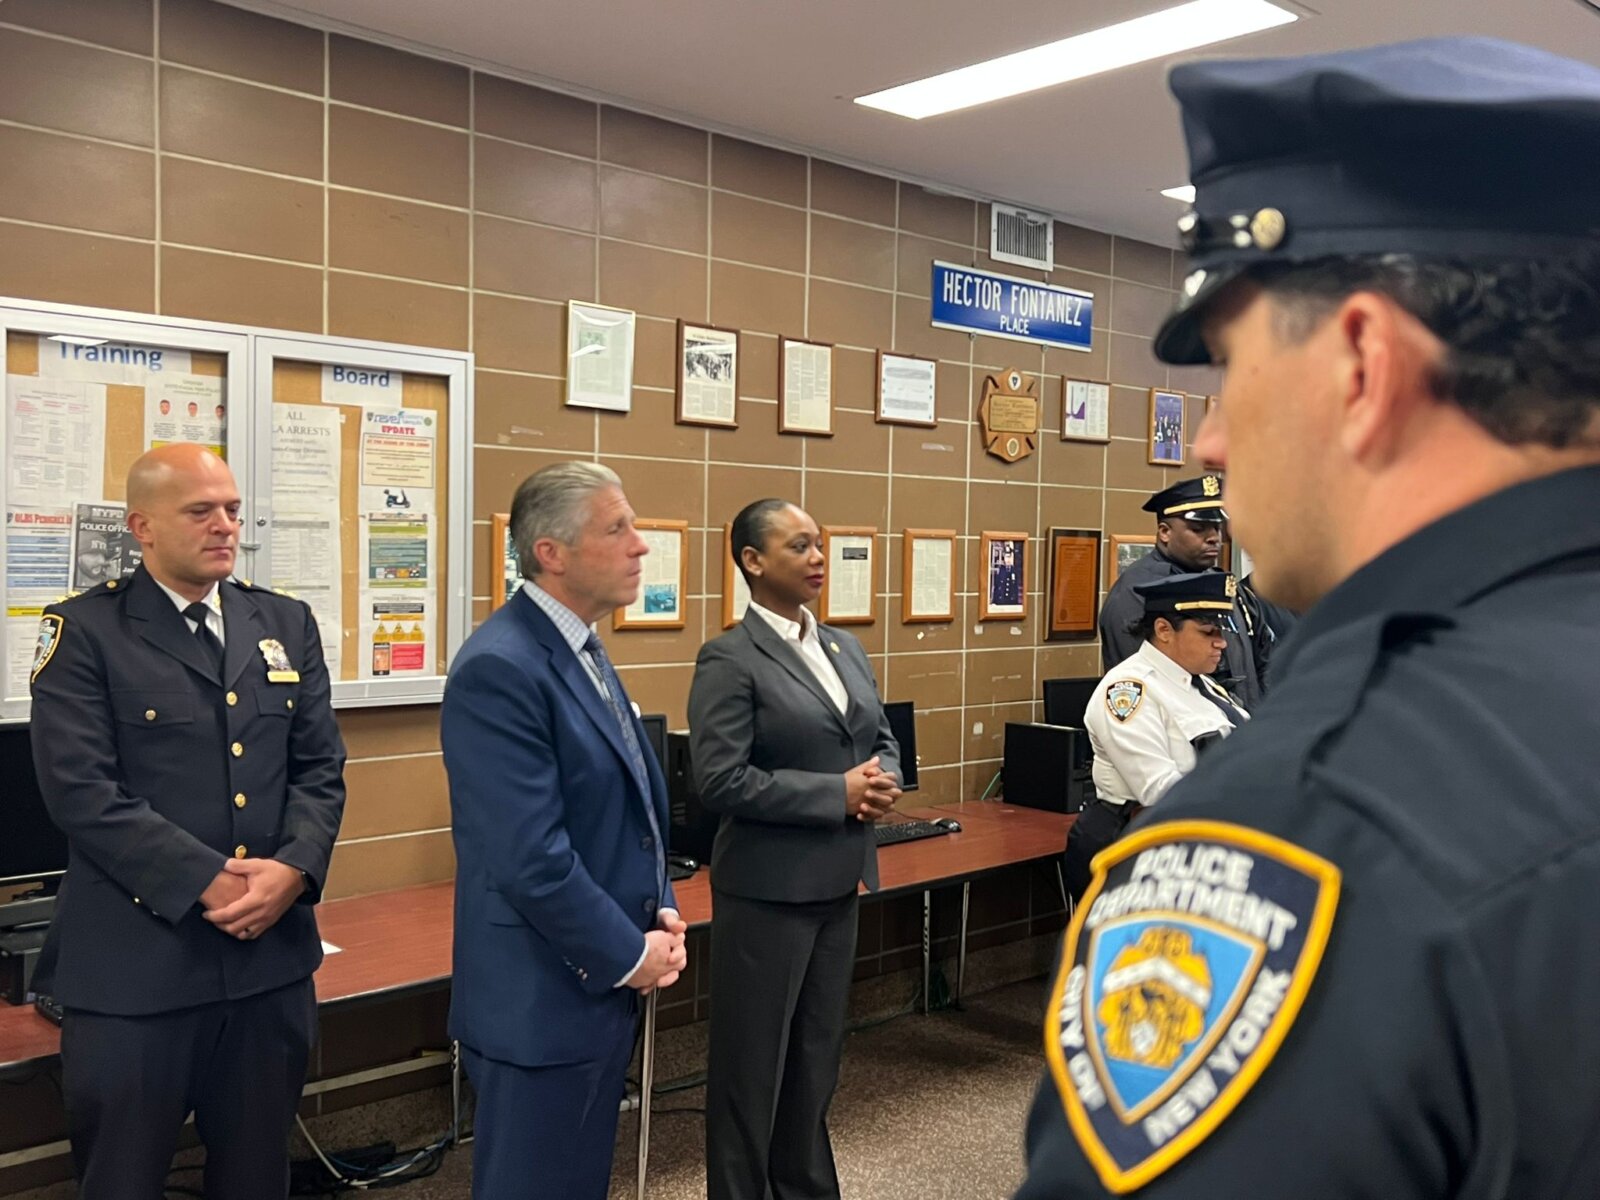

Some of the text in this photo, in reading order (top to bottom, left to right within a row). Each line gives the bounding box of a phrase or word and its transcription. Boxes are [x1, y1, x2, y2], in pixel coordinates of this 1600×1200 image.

[942, 270, 1083, 327] HECTOR FONTANEZ
[1000, 315, 1030, 335] PLACE
[59, 341, 163, 371] Training
[332, 365, 390, 387] Board
[286, 426, 331, 437] ARRESTS
[381, 425, 416, 435] UPDATE
[80, 522, 132, 533] POLICE OFFIC
[1130, 842, 1254, 892] POLICE
[1143, 965, 1293, 1148] NEW YORK
